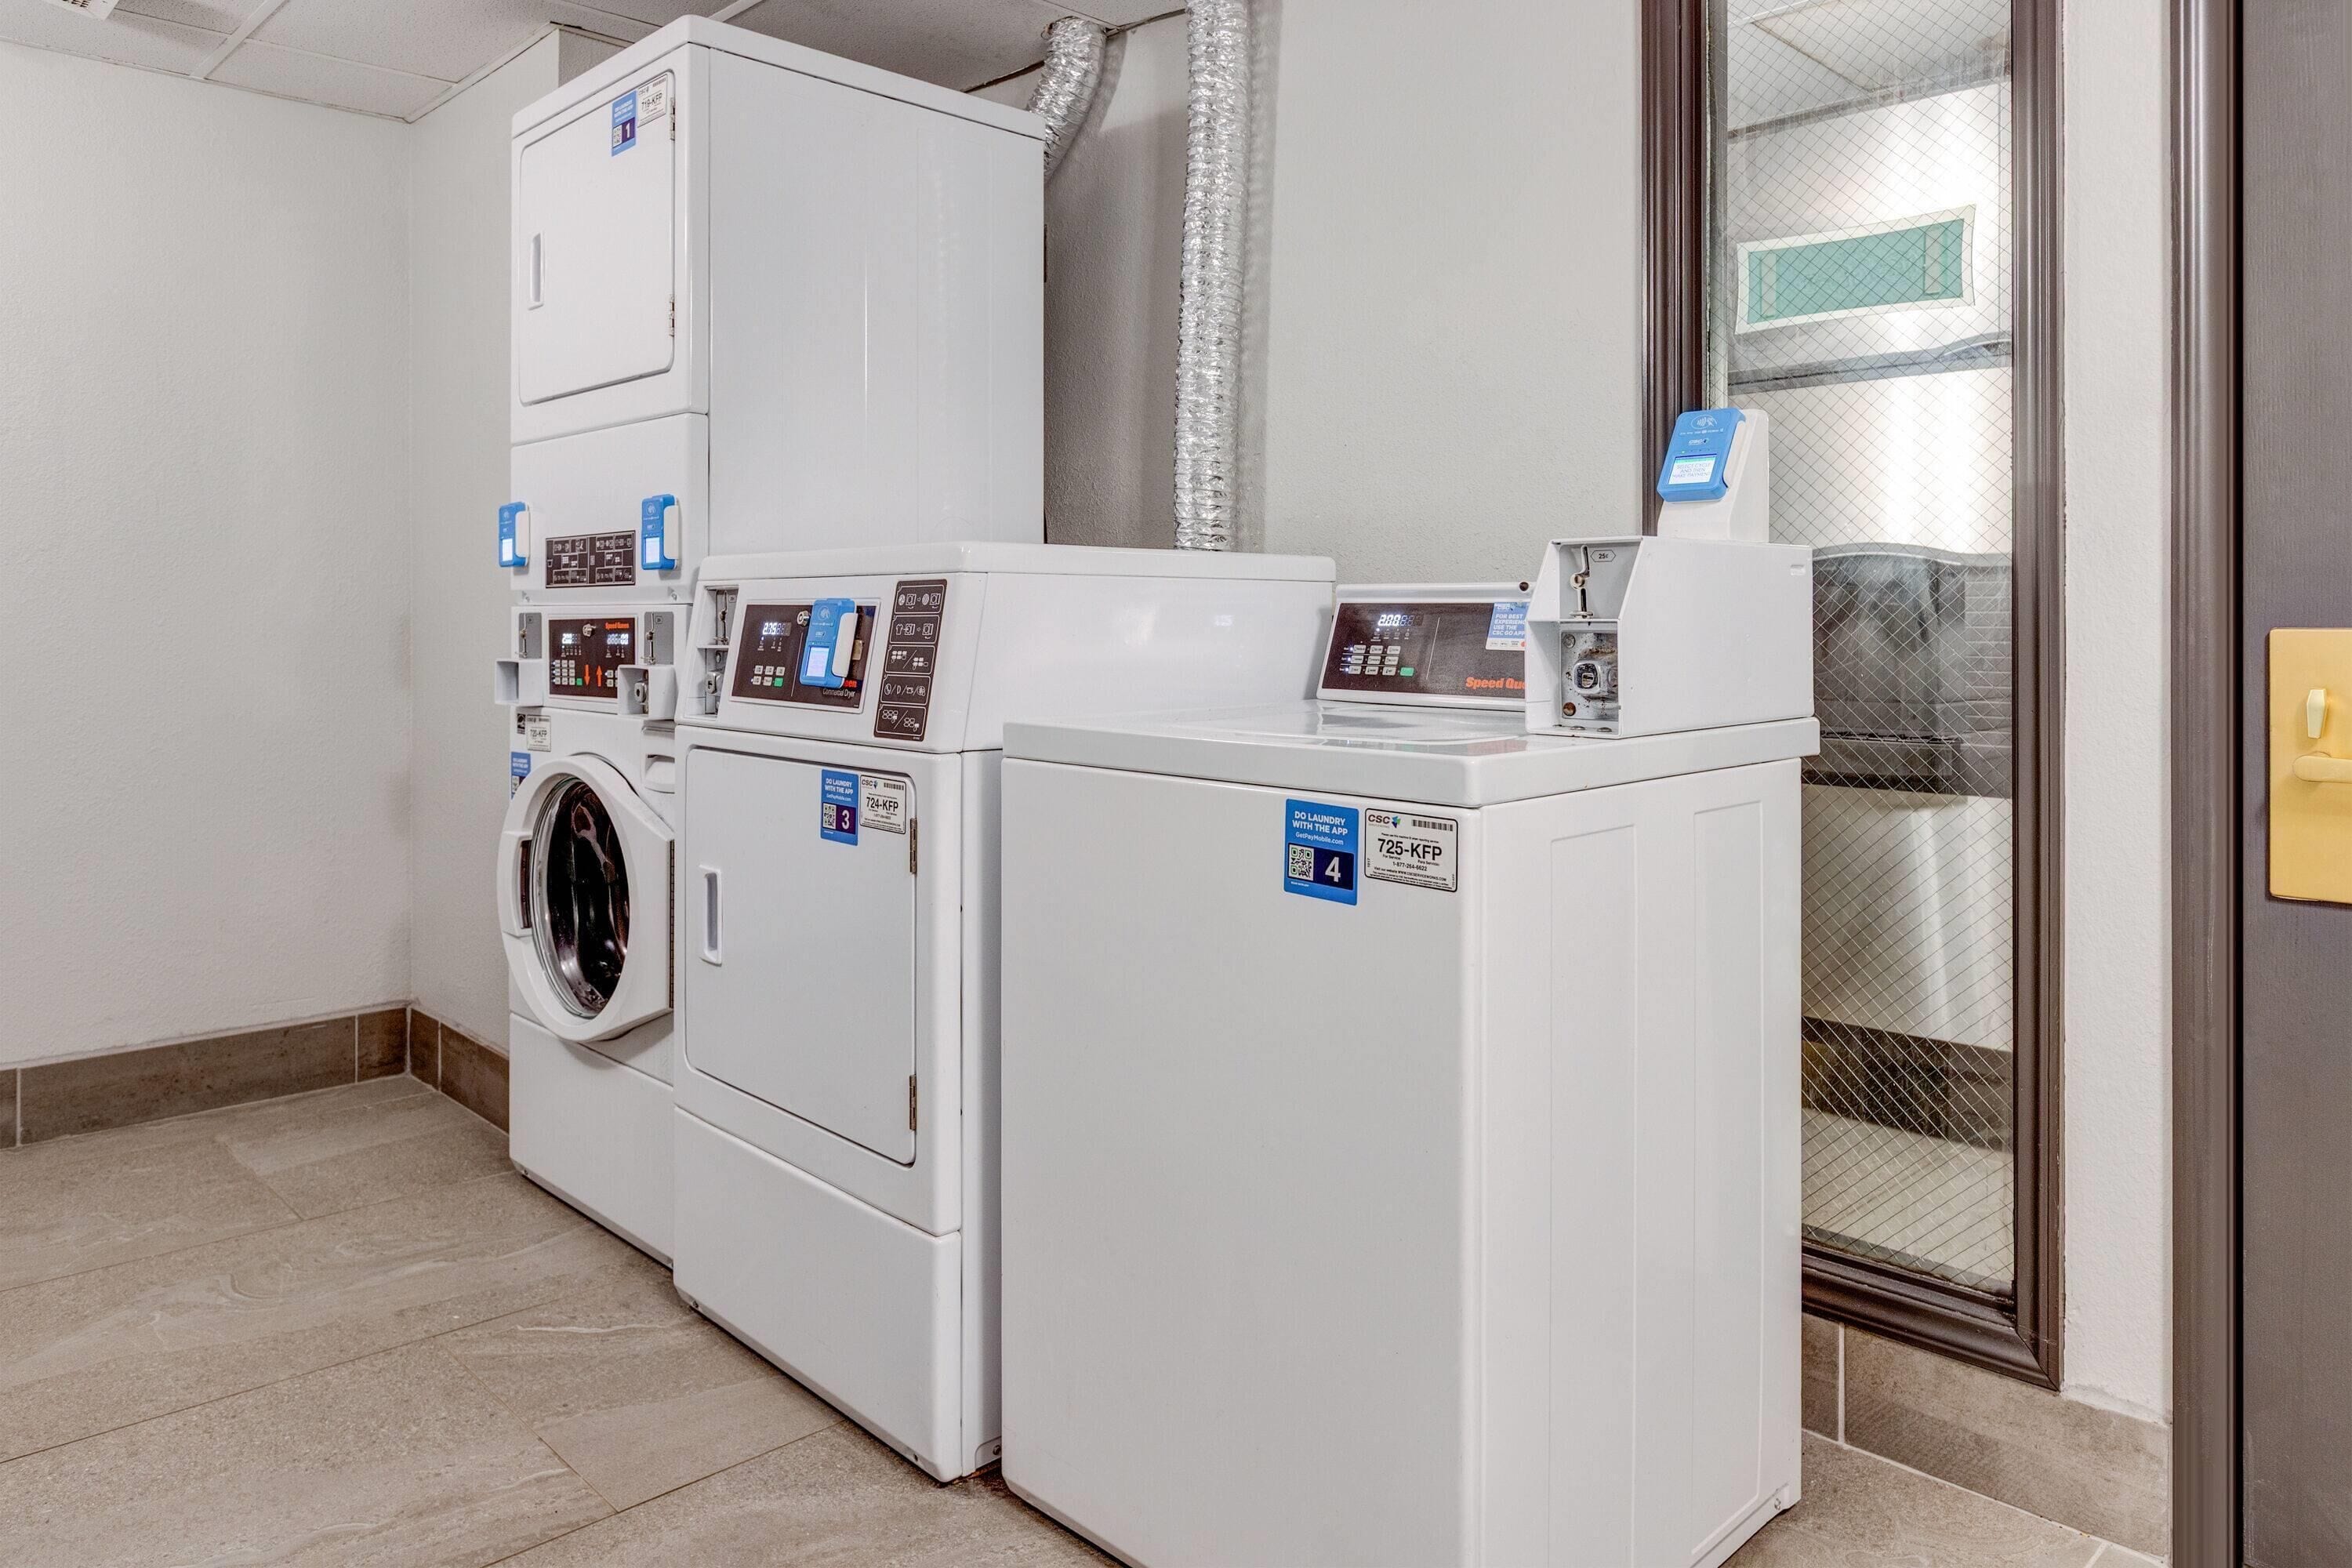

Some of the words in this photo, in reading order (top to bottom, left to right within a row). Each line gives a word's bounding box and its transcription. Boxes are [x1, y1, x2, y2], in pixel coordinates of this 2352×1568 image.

[626, 123, 630, 138] 1
[1466, 677, 1504, 690] Speed
[844, 689, 856, 699] Dryer
[833, 779, 852, 788] LAUNDRY
[866, 797, 898, 812] 724-KFP
[841, 809, 850, 829] 3
[1295, 811, 1306, 820] DO
[1308, 813, 1346, 826] LAUNDRY
[1368, 814, 1390, 824] CSC
[1292, 820, 1313, 830] WITH
[1315, 824, 1330, 833] THE
[1332, 827, 1348, 836] APP
[1295, 832, 1344, 845] GetPayMobile.com
[1377, 838, 1442, 861] 725-KFP
[1325, 857, 1341, 882] 4
